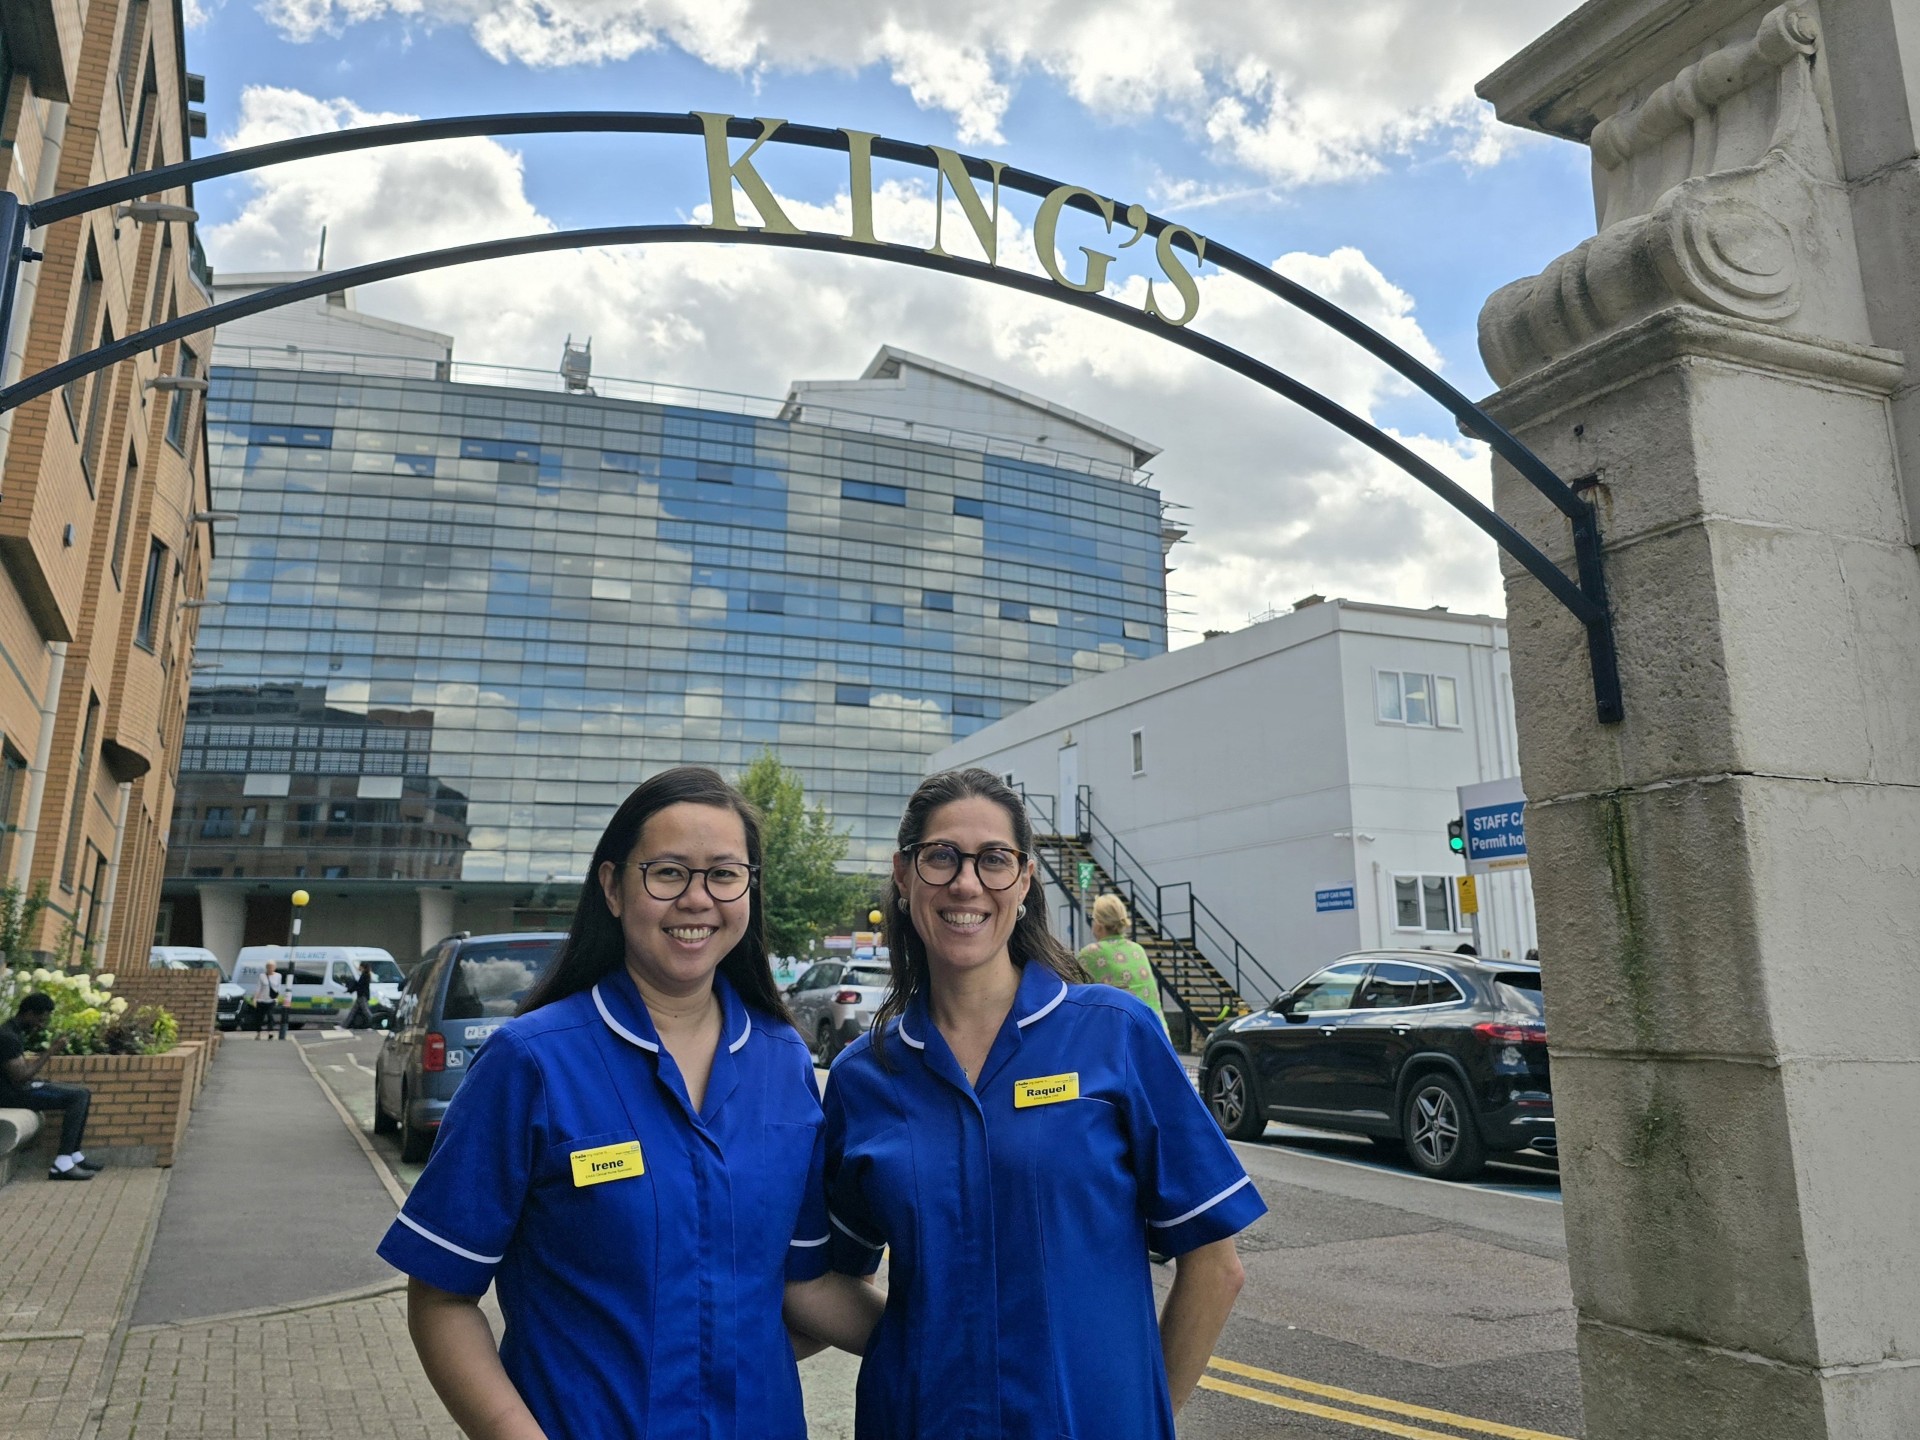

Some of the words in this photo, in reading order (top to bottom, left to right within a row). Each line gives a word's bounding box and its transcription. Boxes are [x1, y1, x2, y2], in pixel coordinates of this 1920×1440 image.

[689, 111, 1206, 326] KING'S
[1473, 813, 1509, 831] STAFF
[1471, 833, 1508, 851] Permit
[1081, 879, 1088, 888] 2
[284, 951, 327, 959] ABULANCE
[1026, 1084, 1066, 1097] Raquel
[591, 1159, 624, 1172] Irene
